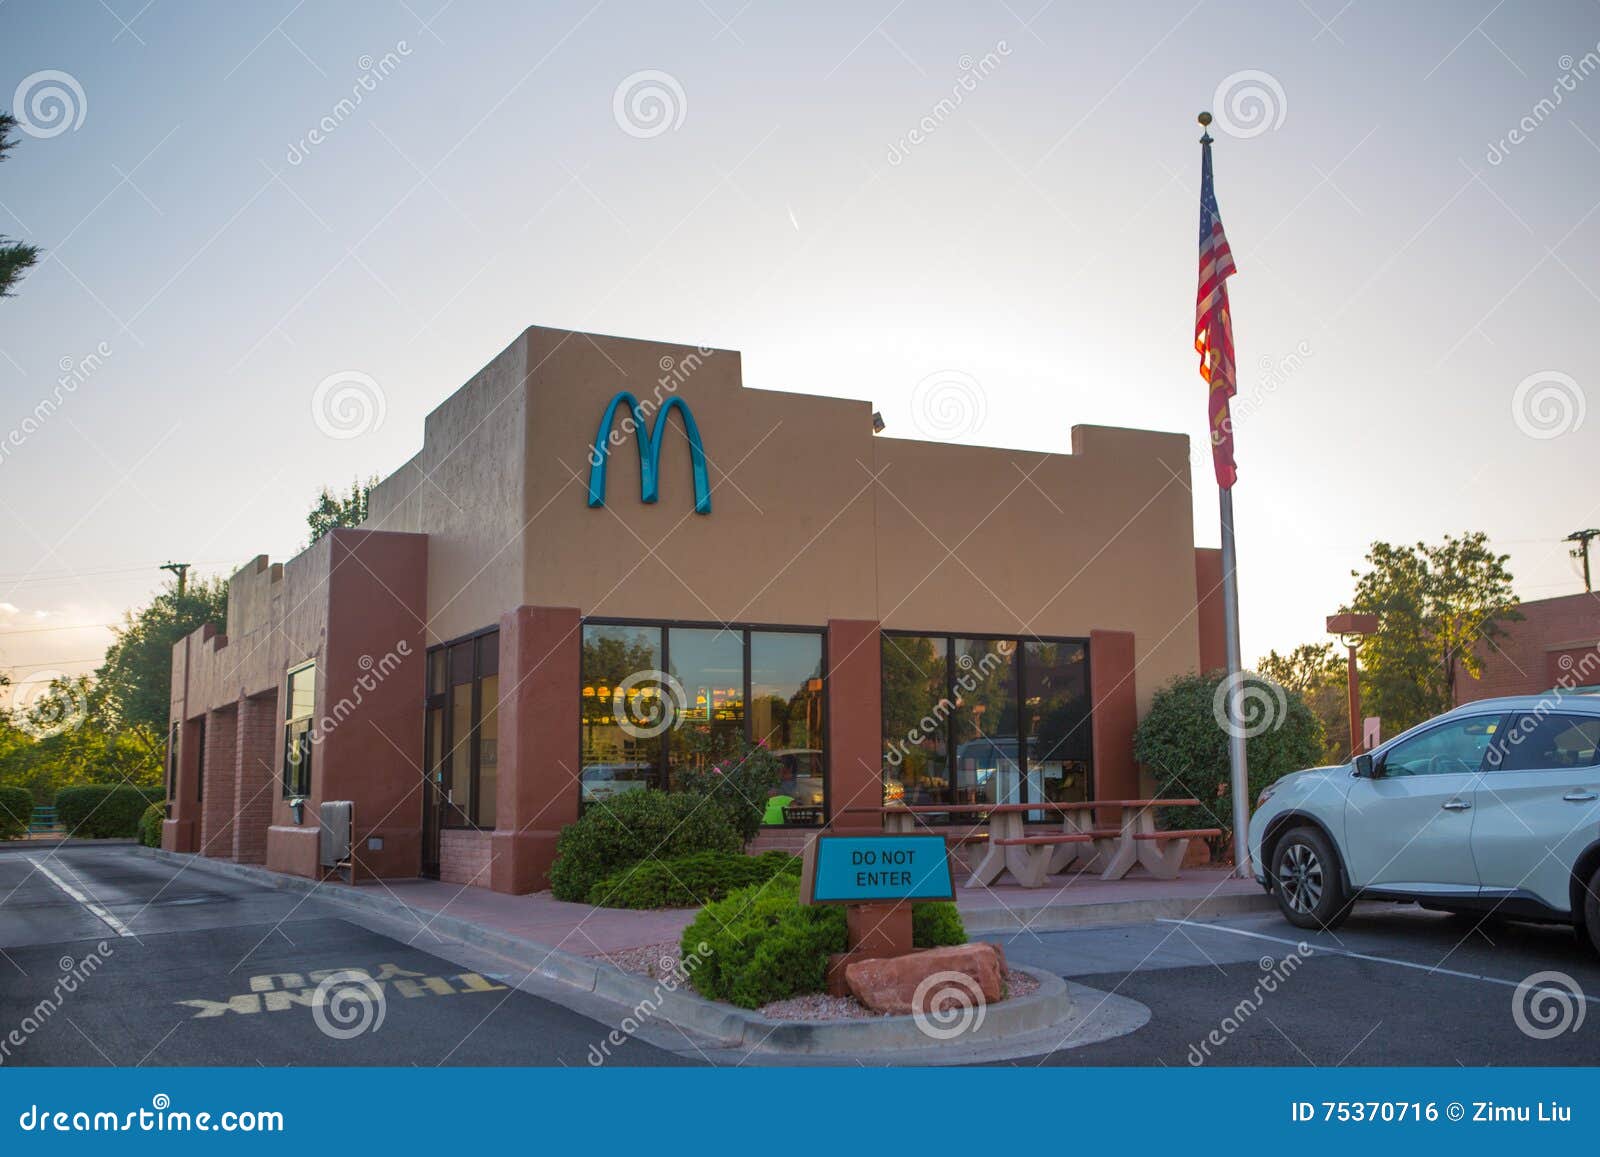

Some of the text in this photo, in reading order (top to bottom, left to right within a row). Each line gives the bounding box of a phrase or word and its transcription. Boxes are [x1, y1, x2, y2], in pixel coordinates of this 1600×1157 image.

[852, 850, 915, 865] DO NOT
[856, 871, 912, 887] ENTER
[249, 963, 426, 993] YOU
